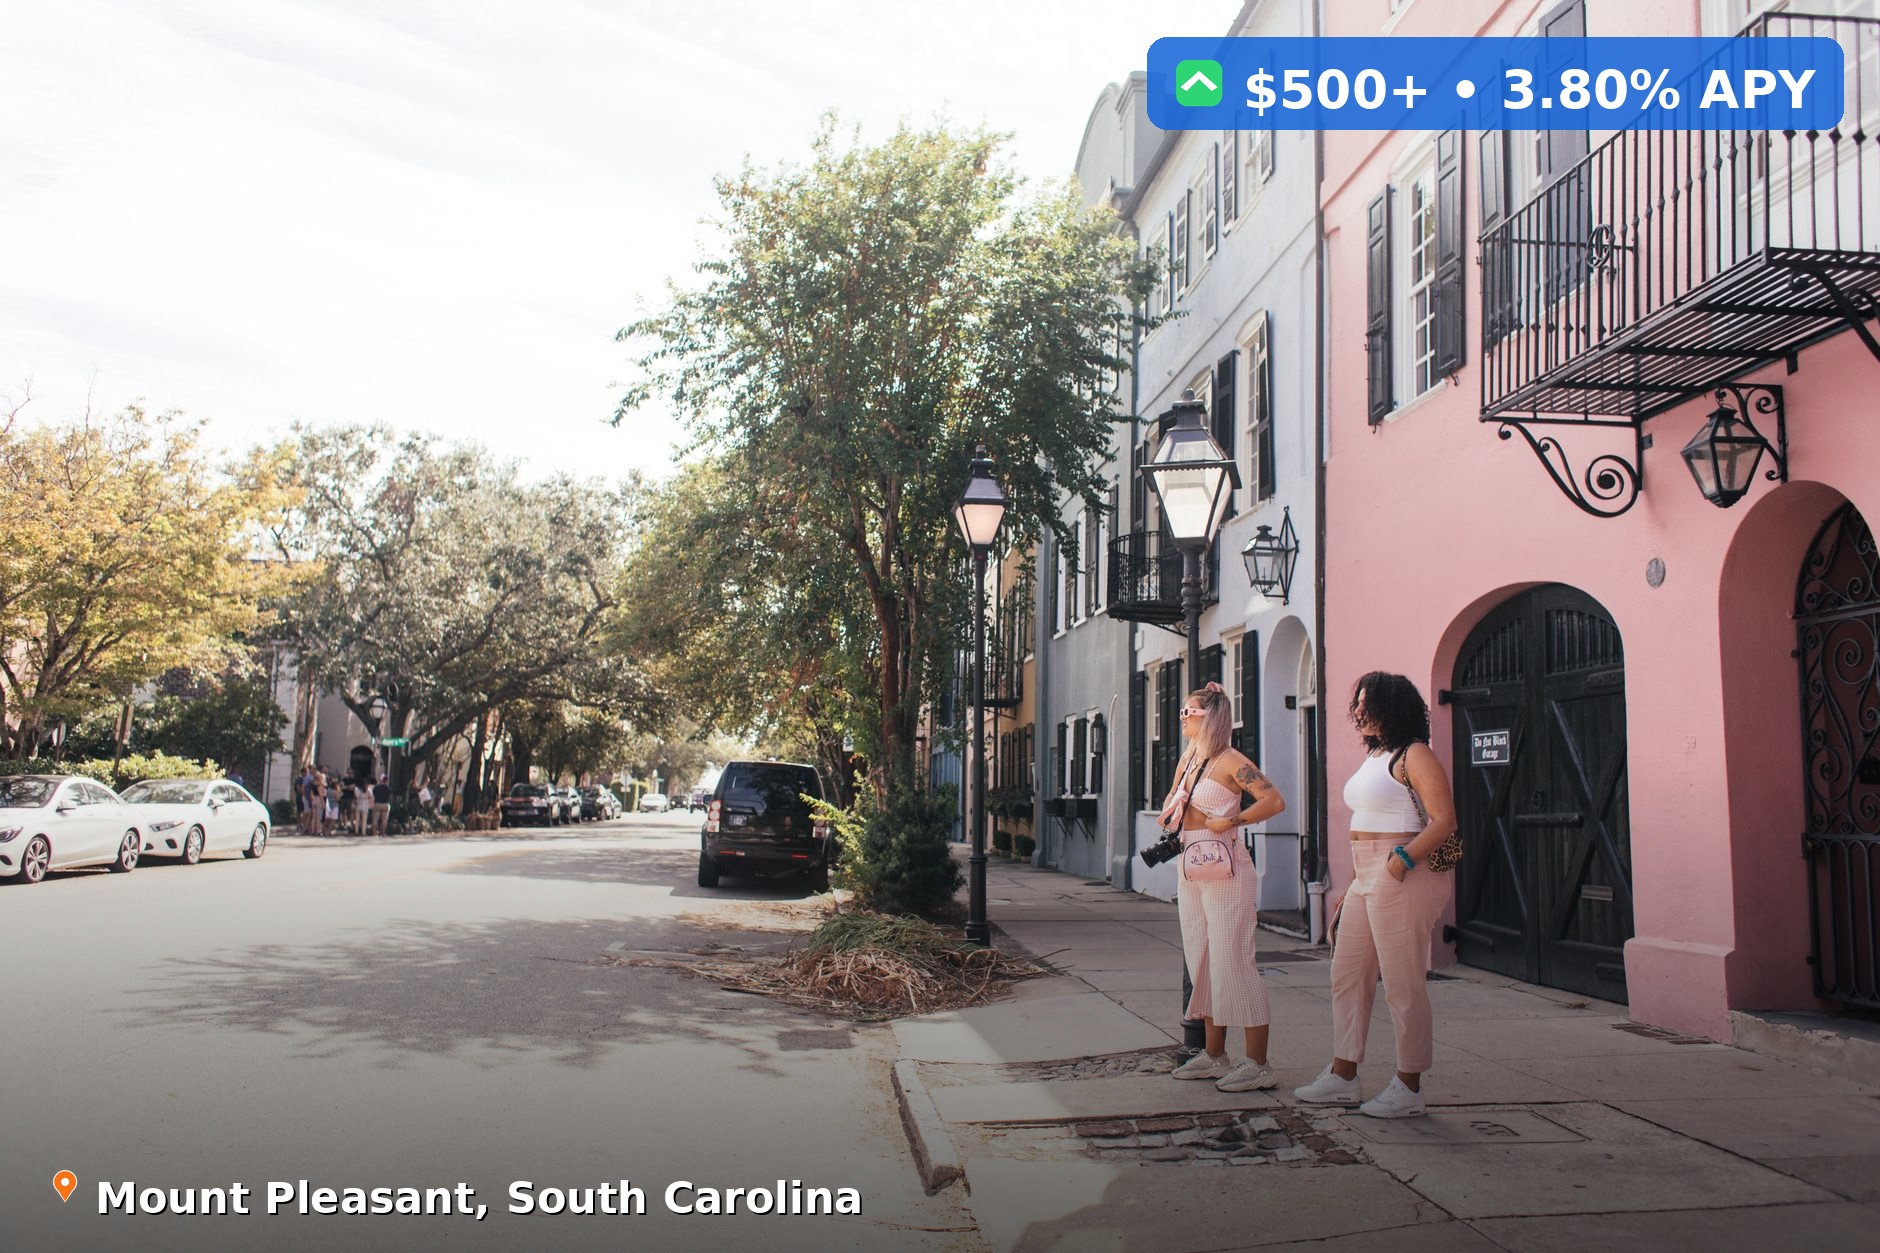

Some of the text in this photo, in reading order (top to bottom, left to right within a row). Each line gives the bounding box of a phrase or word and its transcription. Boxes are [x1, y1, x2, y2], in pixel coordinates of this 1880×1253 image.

[1474, 735, 1507, 748] Do Not Block
